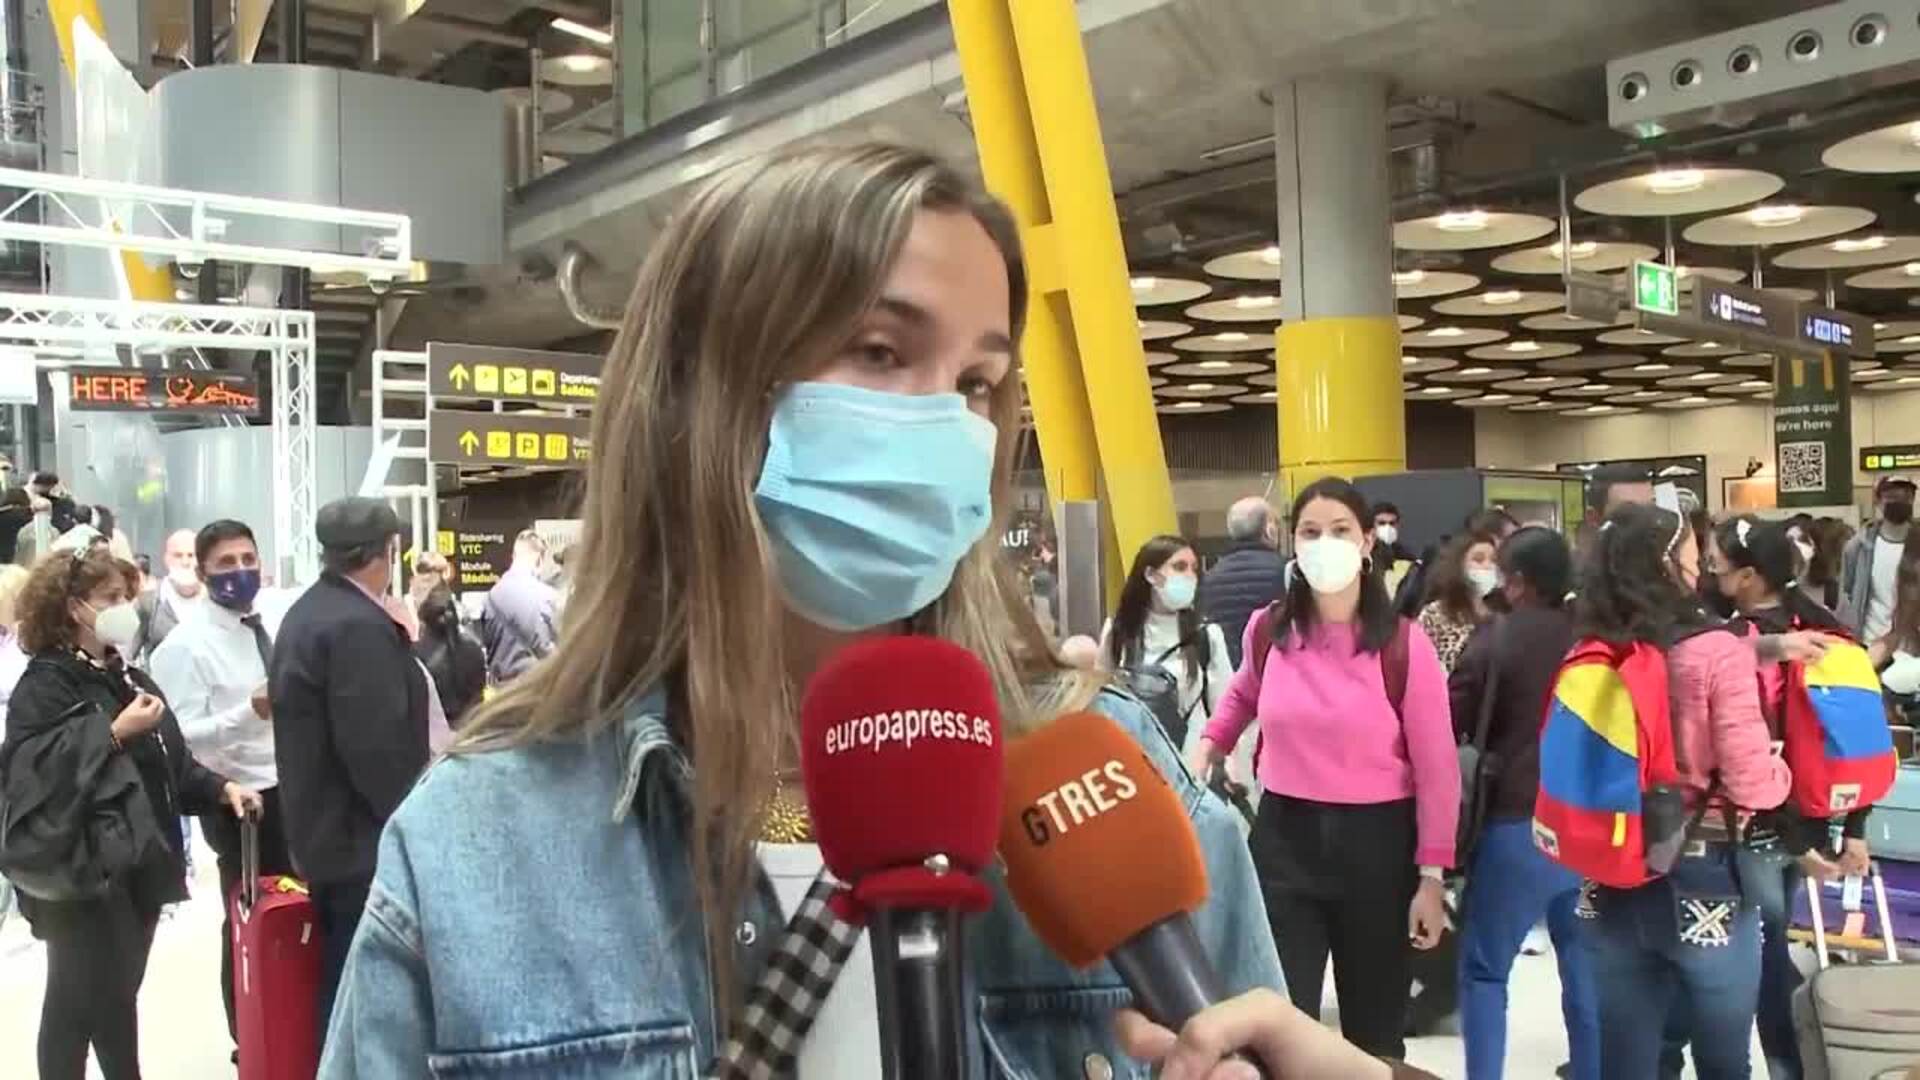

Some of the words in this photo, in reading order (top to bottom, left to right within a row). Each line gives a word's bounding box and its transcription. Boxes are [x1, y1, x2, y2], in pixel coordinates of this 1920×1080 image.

[73, 376, 147, 400] HERE
[460, 544, 482, 555] VTC
[461, 562, 491, 571] Module
[826, 708, 993, 754] europapress.es
[1021, 760, 1137, 846] GTRES
